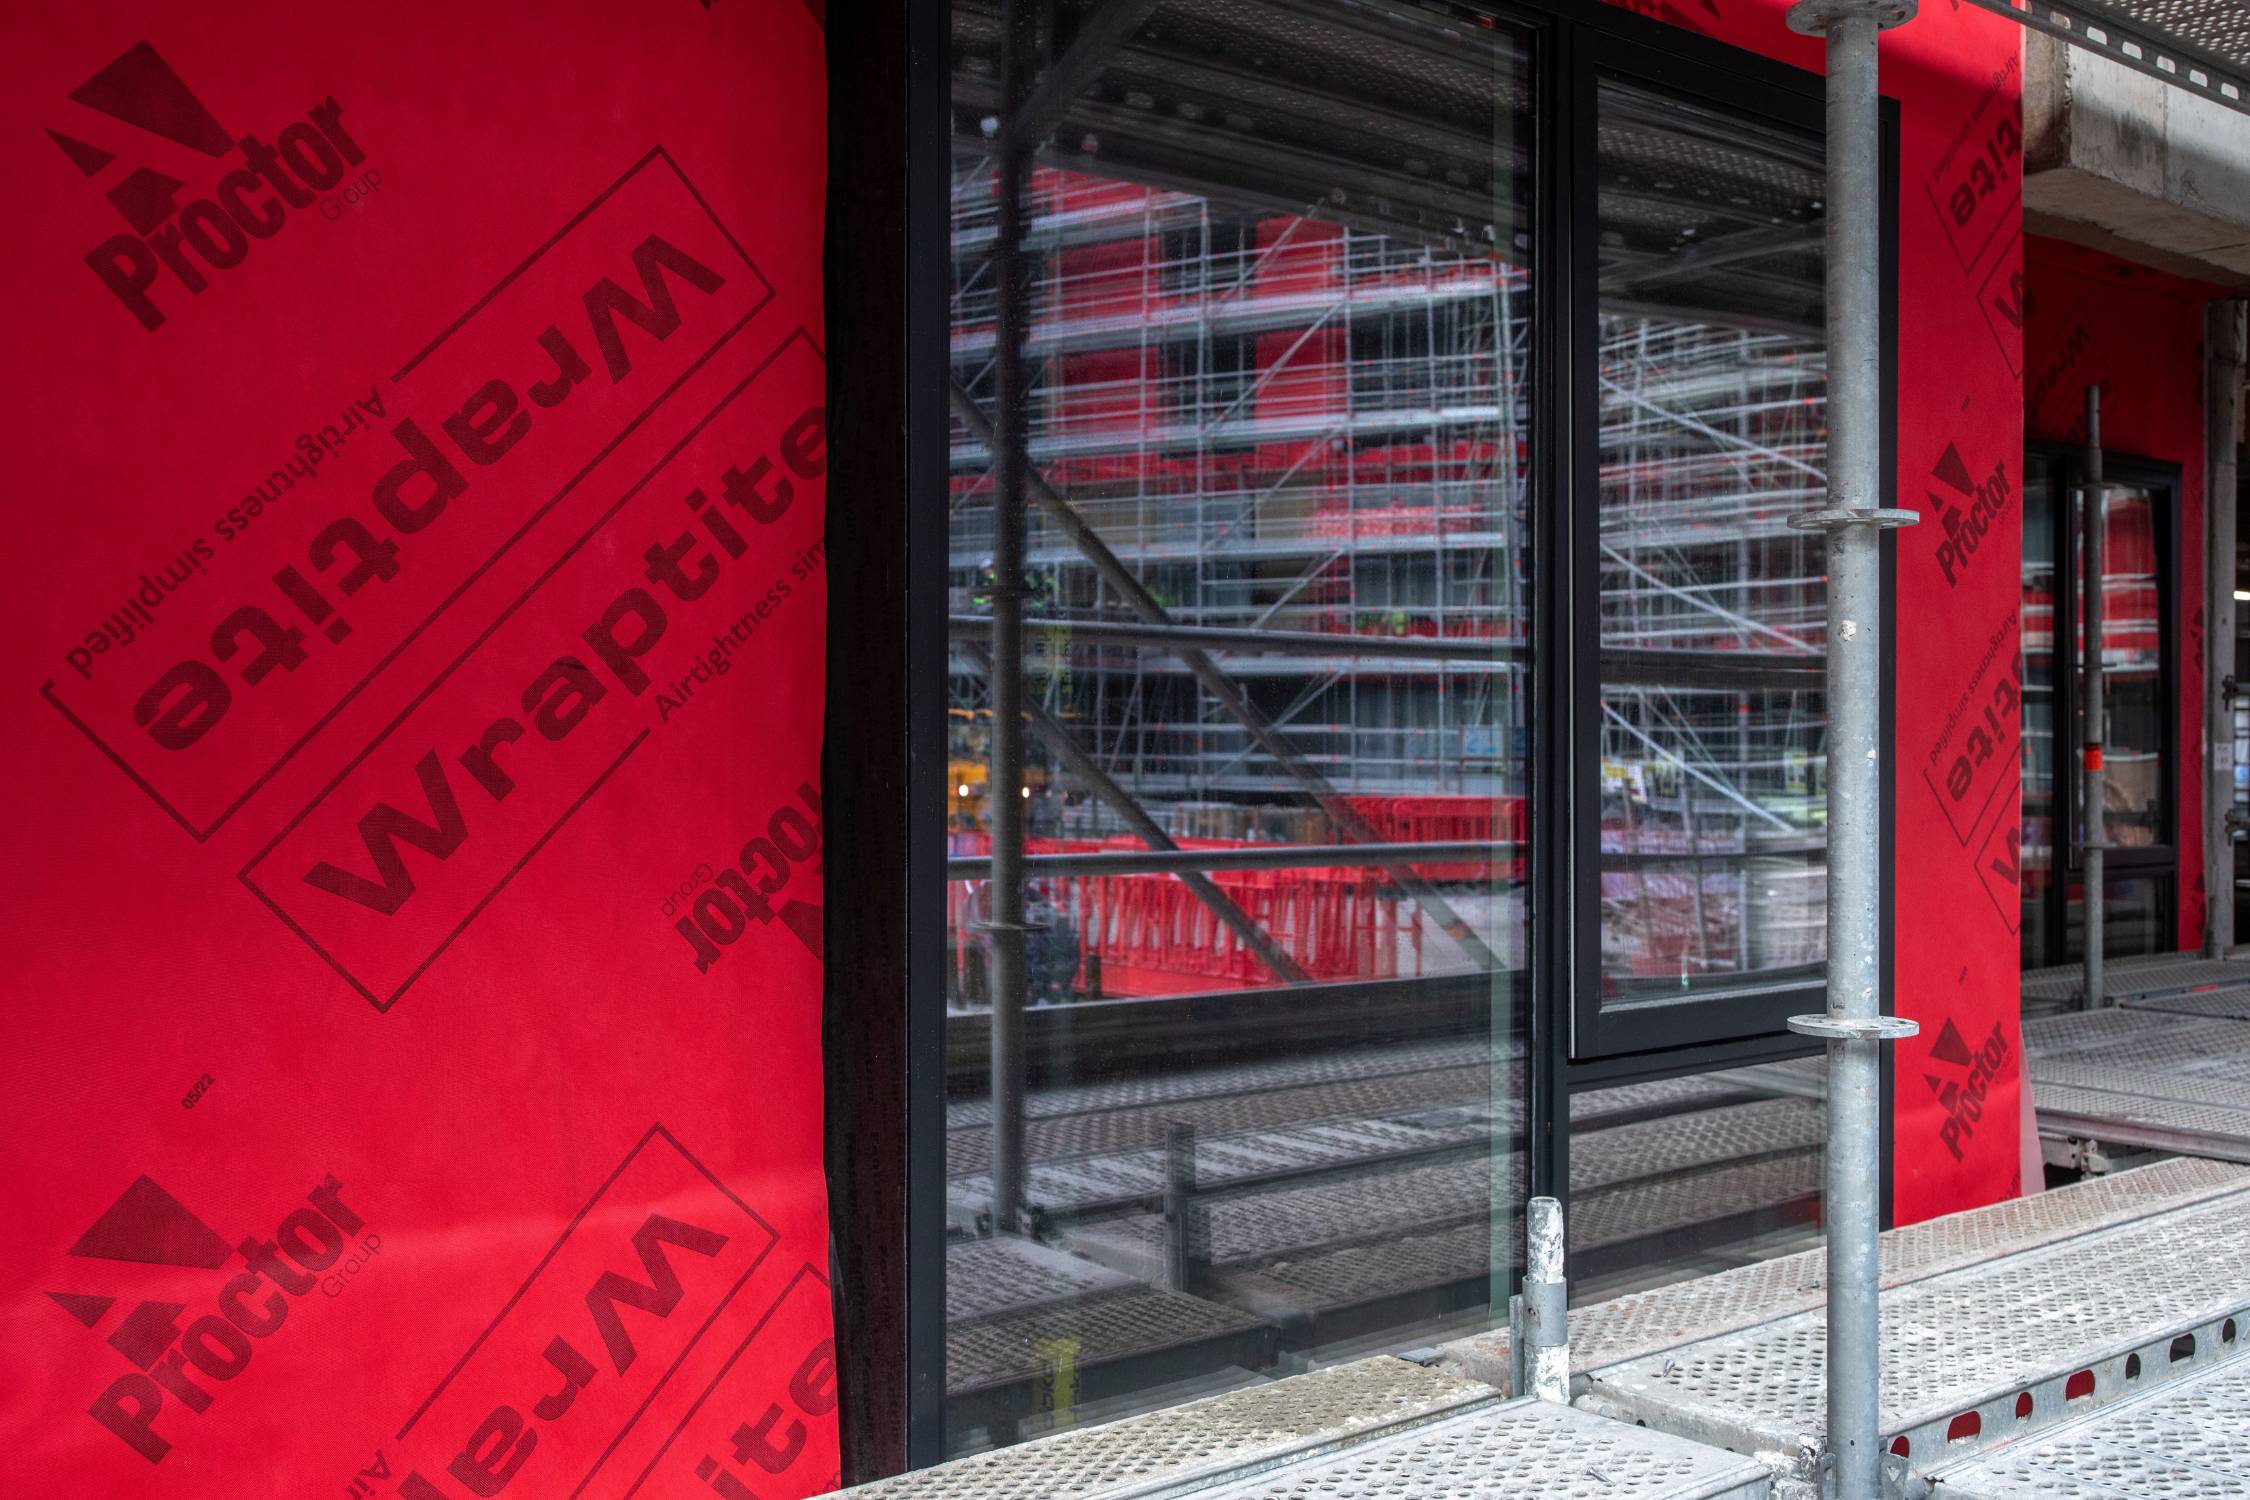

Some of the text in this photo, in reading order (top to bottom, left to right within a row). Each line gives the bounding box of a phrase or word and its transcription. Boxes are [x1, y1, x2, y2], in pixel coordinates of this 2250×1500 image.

[83, 95, 366, 332] Proctor
[319, 168, 383, 222] Group
[67, 383, 388, 678] Airtightness simplified
[133, 234, 727, 752] Wraptite
[1935, 458, 2012, 589] Proctor
[302, 405, 825, 917] Wraptite
[654, 578, 793, 725] Airtightness
[662, 863, 714, 918] Group
[1939, 1018, 2009, 1164] Proctor
[87, 1173, 366, 1465] Proctor
[321, 1231, 383, 1299] Group
